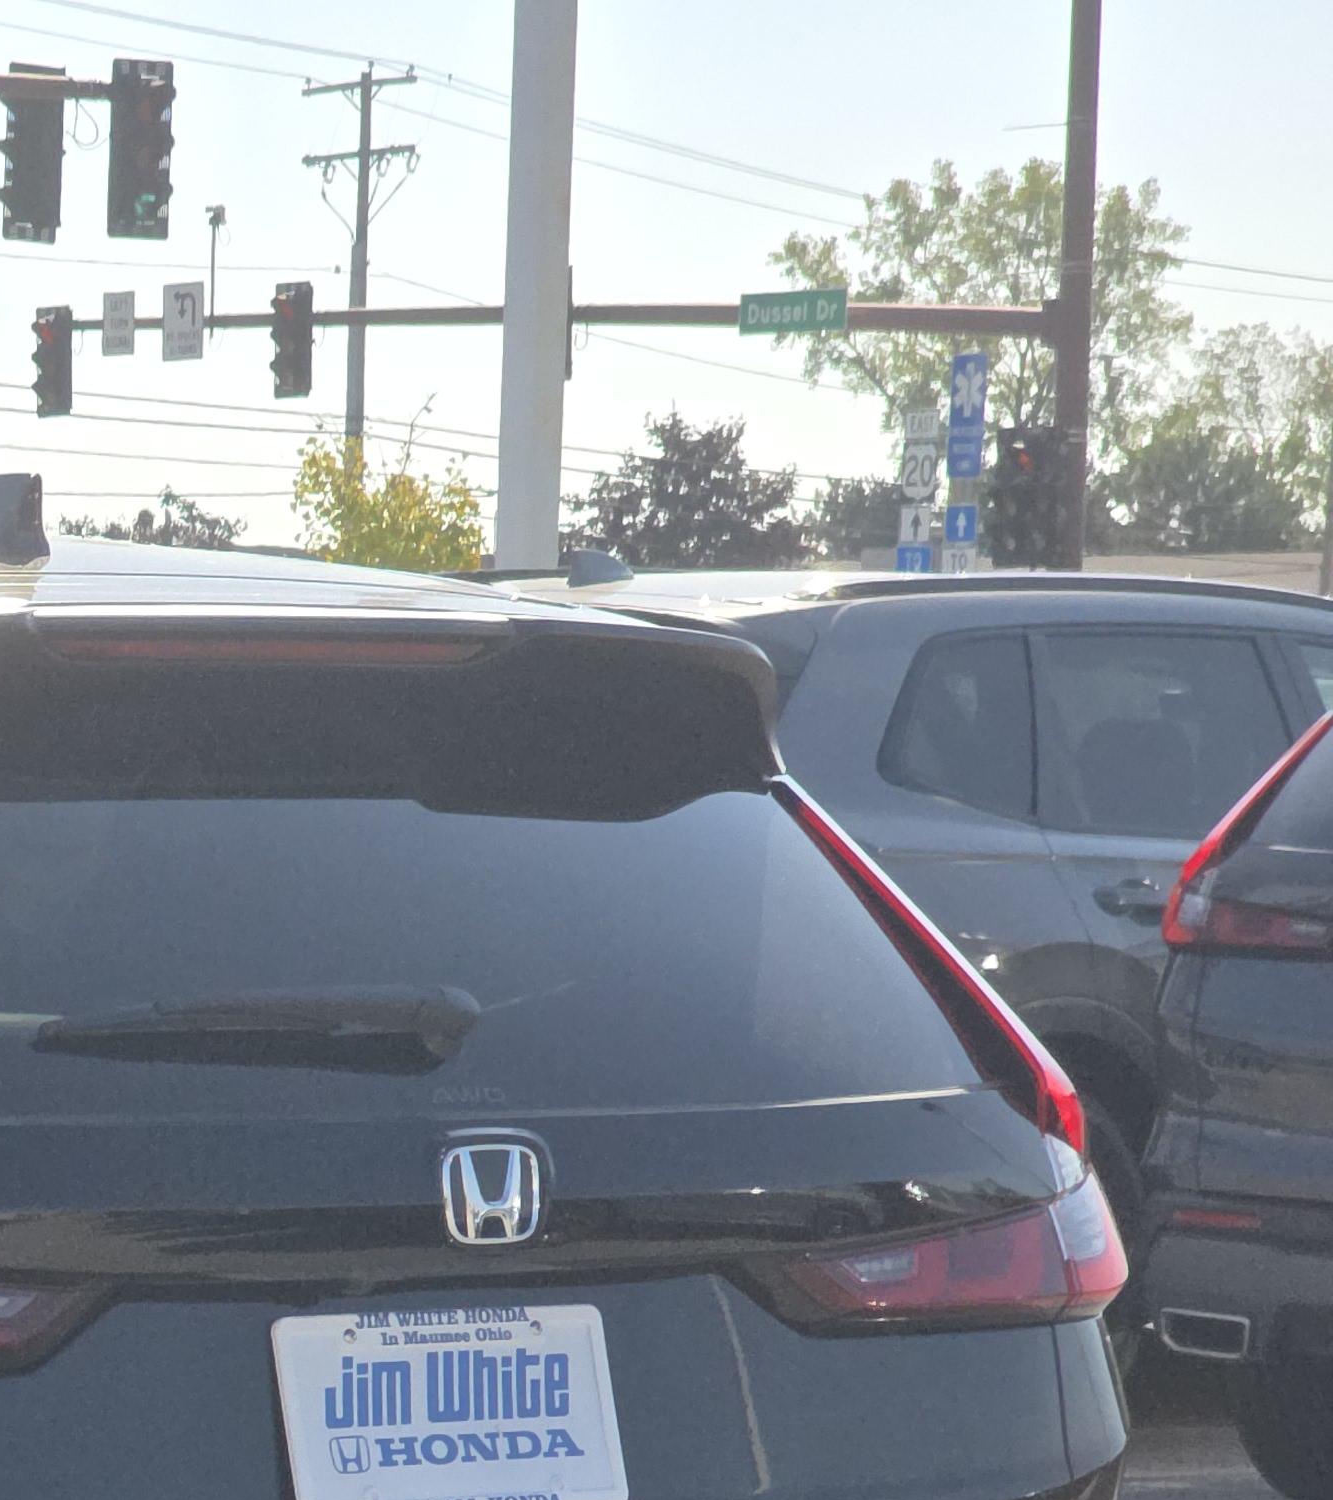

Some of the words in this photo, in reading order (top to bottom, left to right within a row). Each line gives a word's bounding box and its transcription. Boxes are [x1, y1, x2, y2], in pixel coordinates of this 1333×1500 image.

[747, 301, 808, 324] Dussel
[816, 299, 838, 321] Dr
[904, 453, 934, 488] 20
[355, 1312, 391, 1330] JIM
[395, 1309, 459, 1328] WHITE
[463, 1306, 530, 1325] HONDA
[380, 1332, 399, 1346] In
[403, 1329, 471, 1345] Maumee
[475, 1326, 513, 1342] Ohio
[426, 1347, 570, 1424] White
[374, 1428, 585, 1468] HONDA
